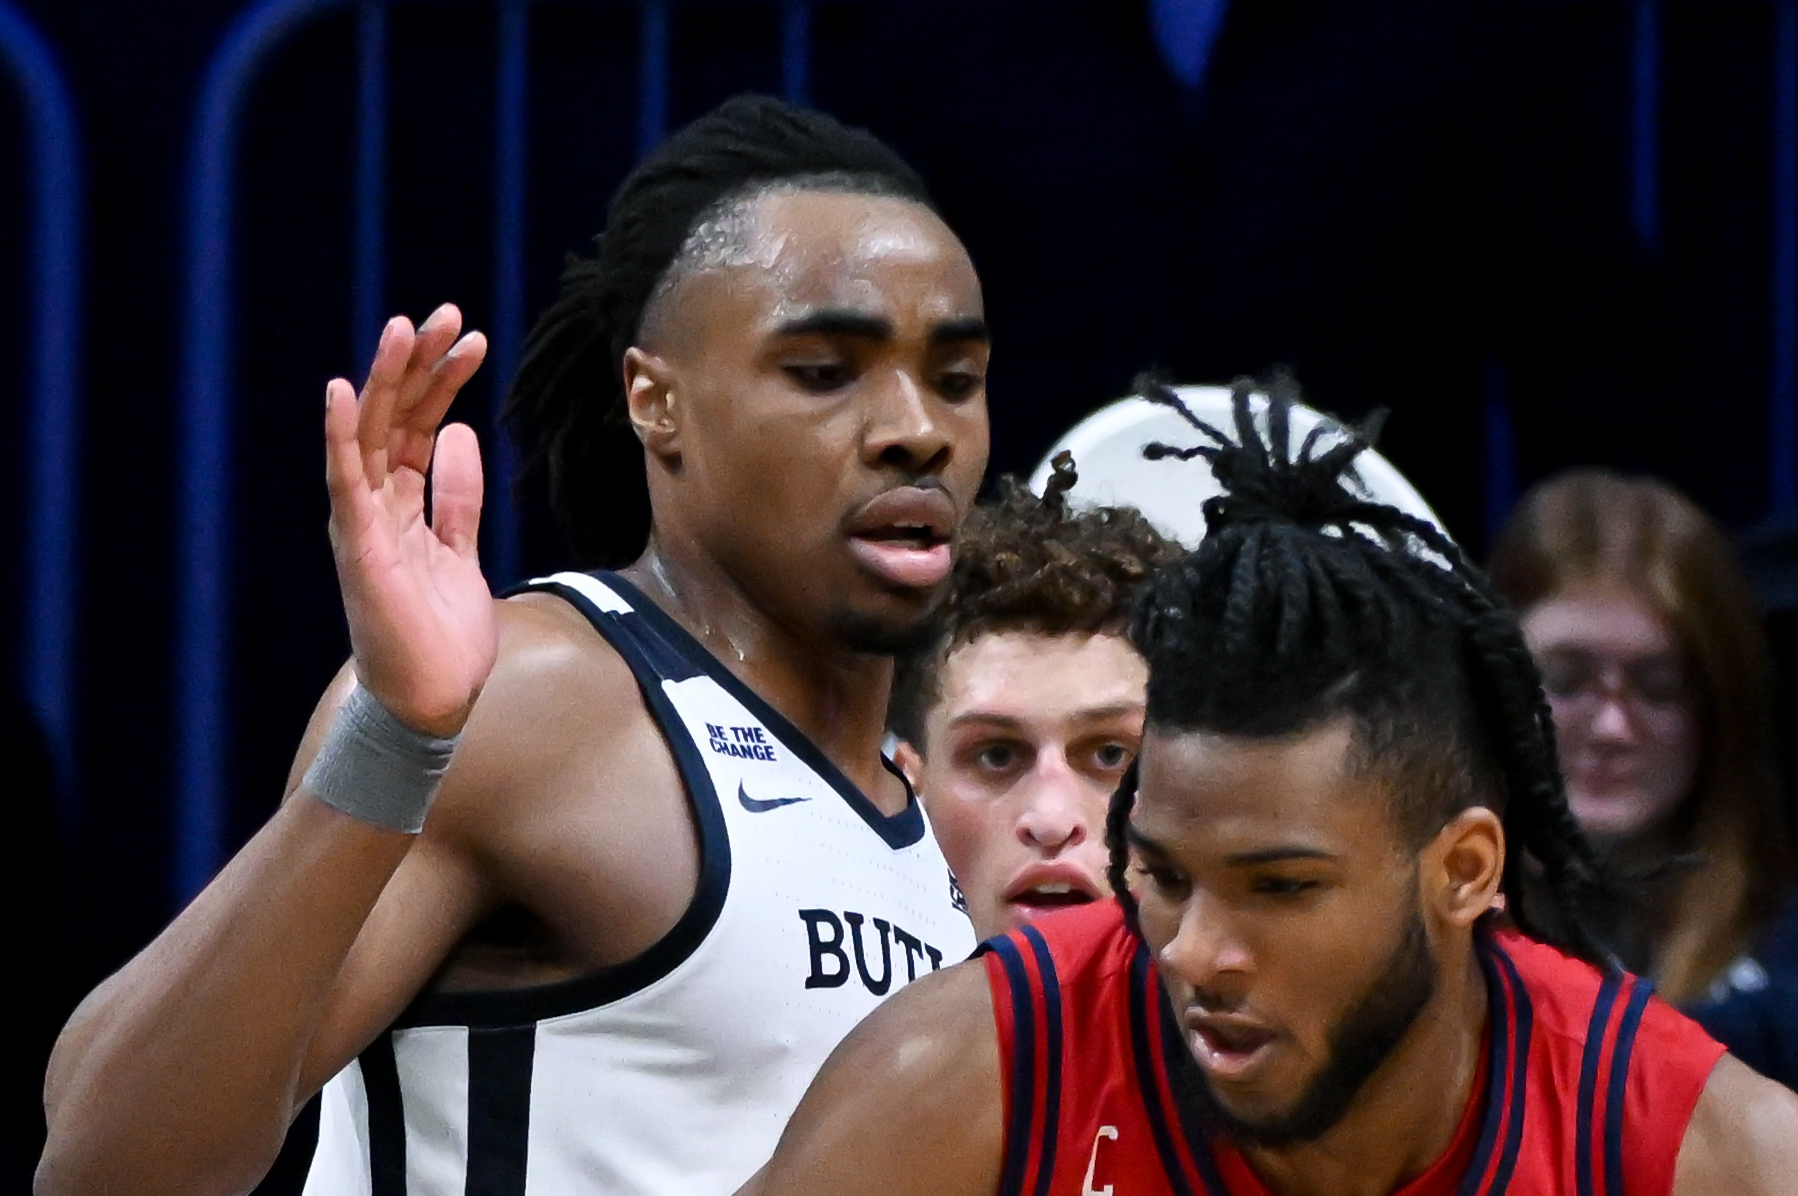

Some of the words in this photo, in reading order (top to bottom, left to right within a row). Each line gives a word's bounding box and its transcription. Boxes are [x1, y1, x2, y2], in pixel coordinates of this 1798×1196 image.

[705, 721, 728, 741] BE
[729, 726, 766, 744] THE
[708, 737, 777, 762] CHANGE
